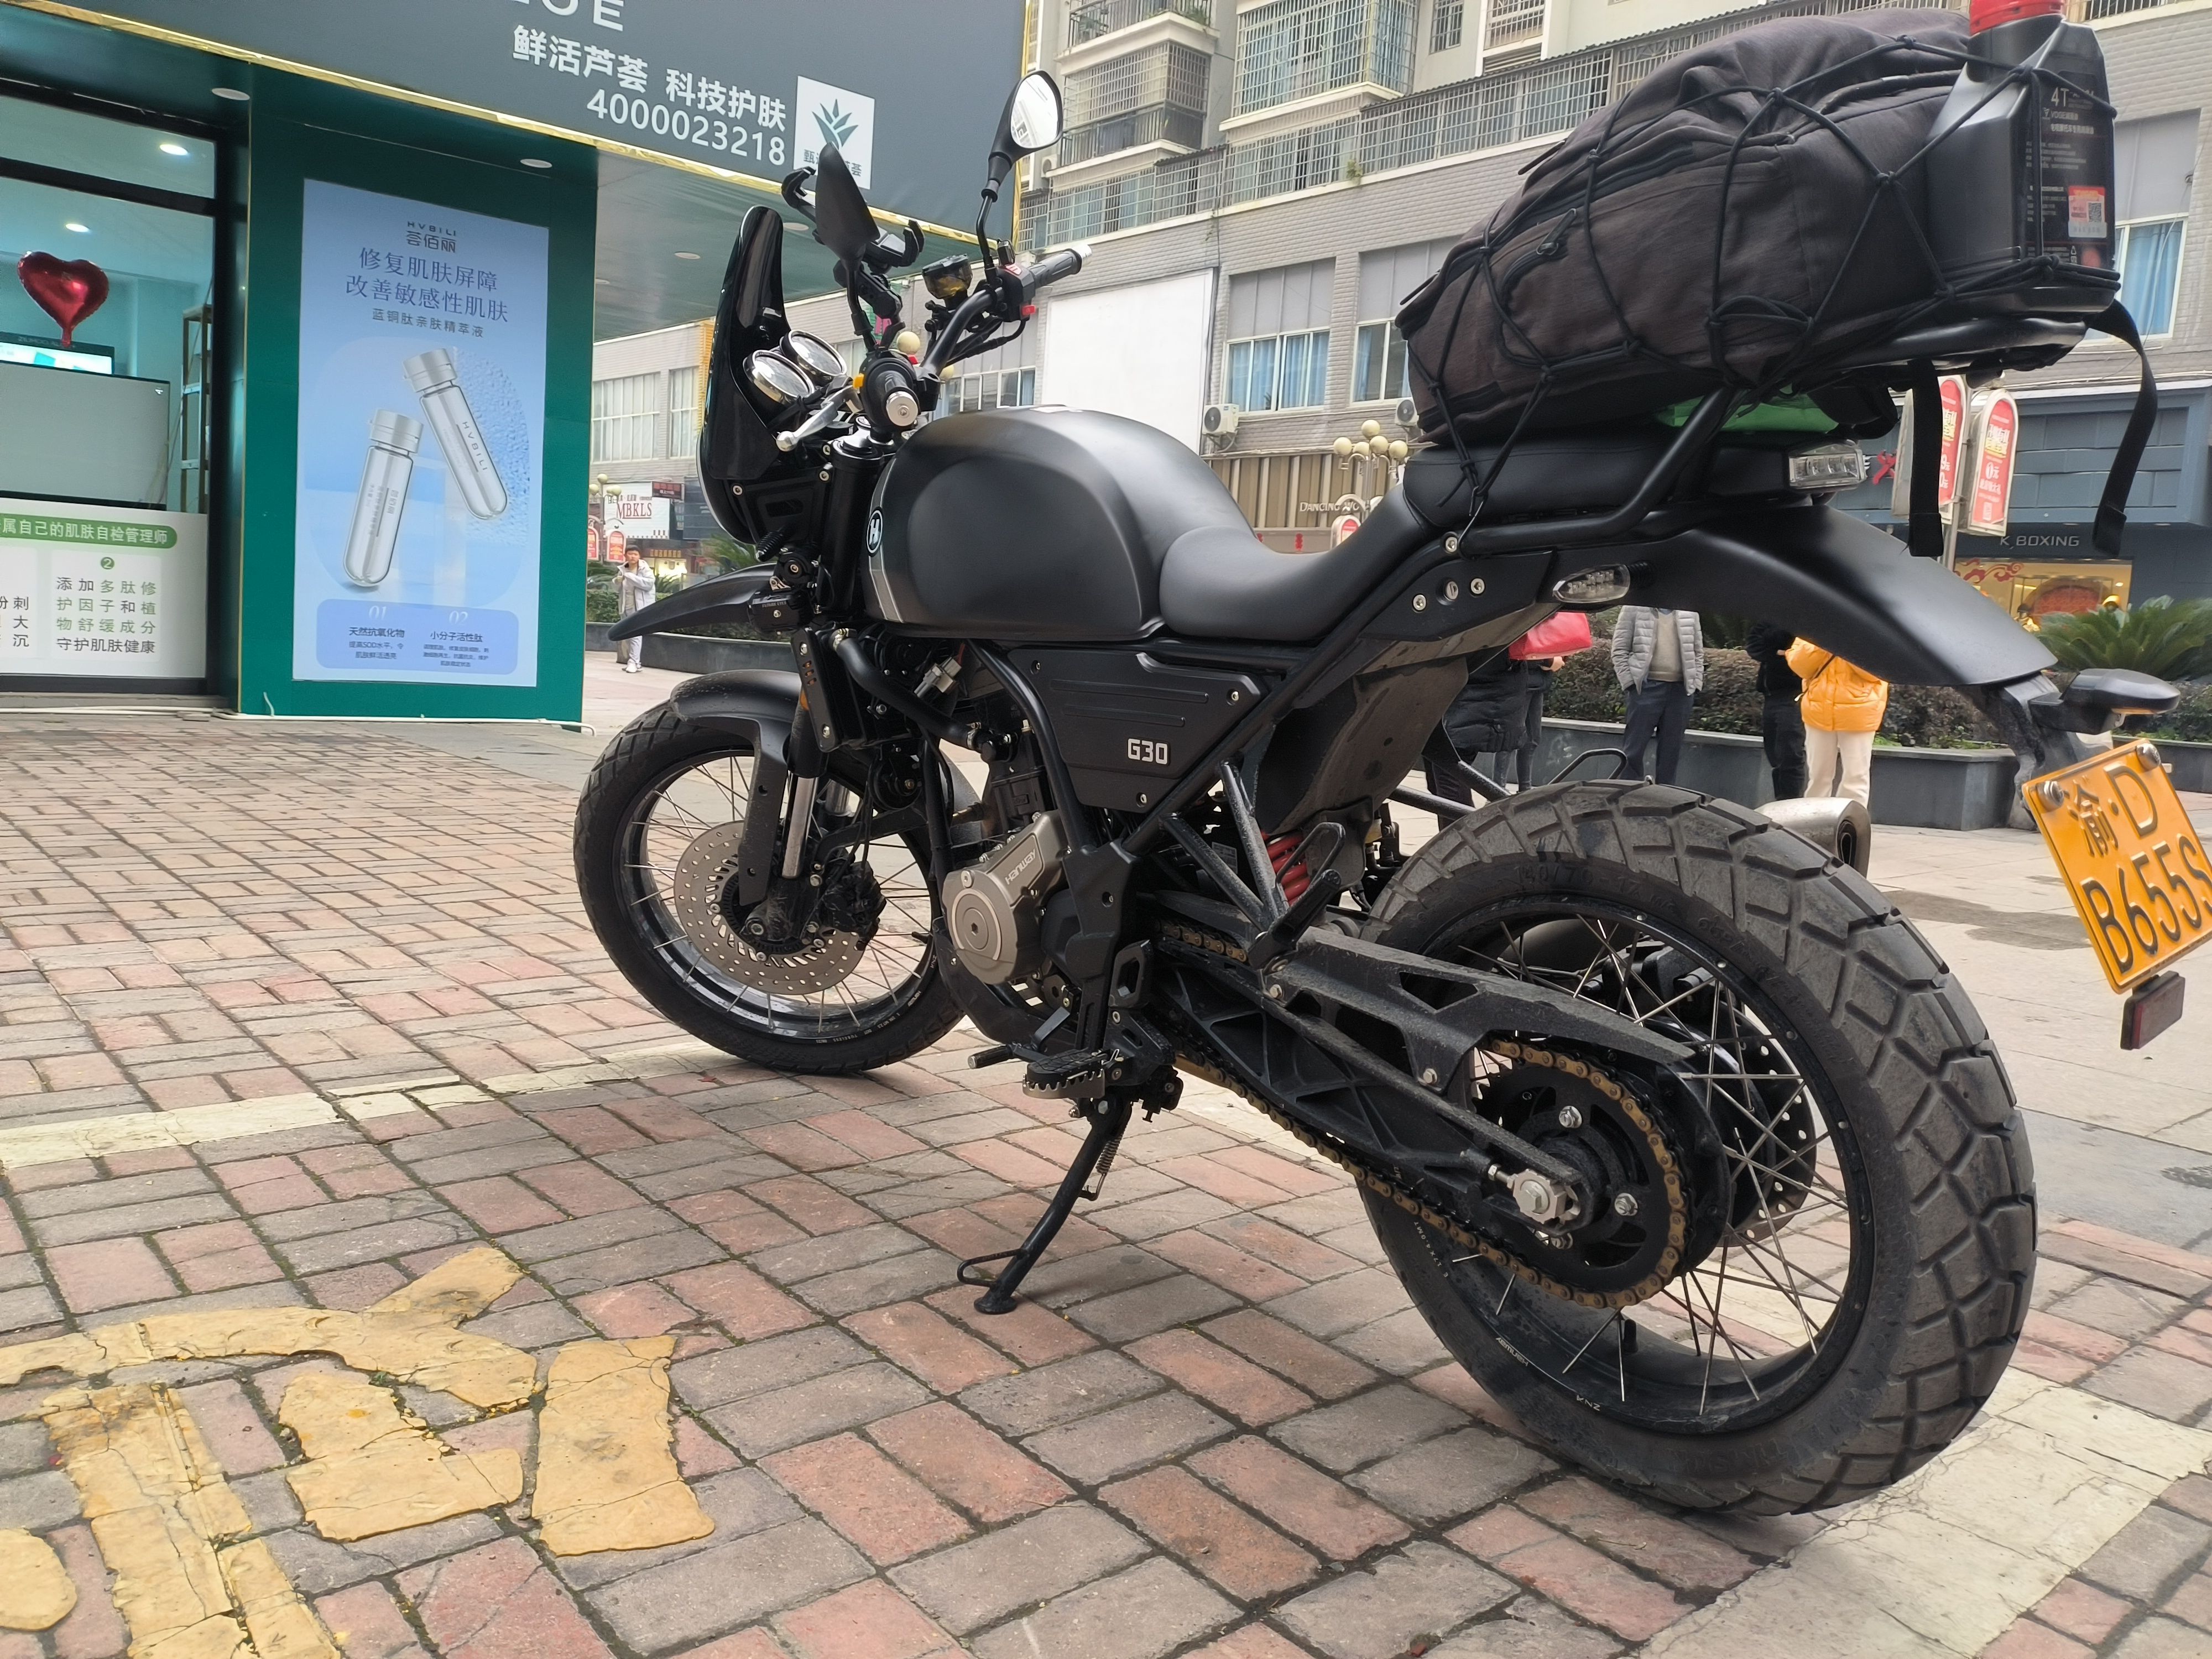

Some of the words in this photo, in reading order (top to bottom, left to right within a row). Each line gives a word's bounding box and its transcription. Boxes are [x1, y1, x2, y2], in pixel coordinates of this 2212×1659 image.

[513, 25, 648, 93] 鲜活芦荟
[665, 69, 786, 133] 科技护肤
[587, 88, 785, 166] 4000023218
[406, 231, 457, 253] 荟佰丽
[359, 248, 497, 292] 修复肌肤屏障
[346, 275, 508, 322] 改善敏感性肌肤
[372, 307, 483, 338] 蓝铜肽亲肤精萃液
[0, 517, 168, 545] 属自己的肌肤自检管理师
[56, 577, 156, 595] 添加多肽修
[56, 597, 156, 615] 护因子和植
[56, 617, 156, 634] 物舒缓成分
[56, 637, 155, 654] 守护肌肤健康
[1128, 738, 1168, 765] G30
